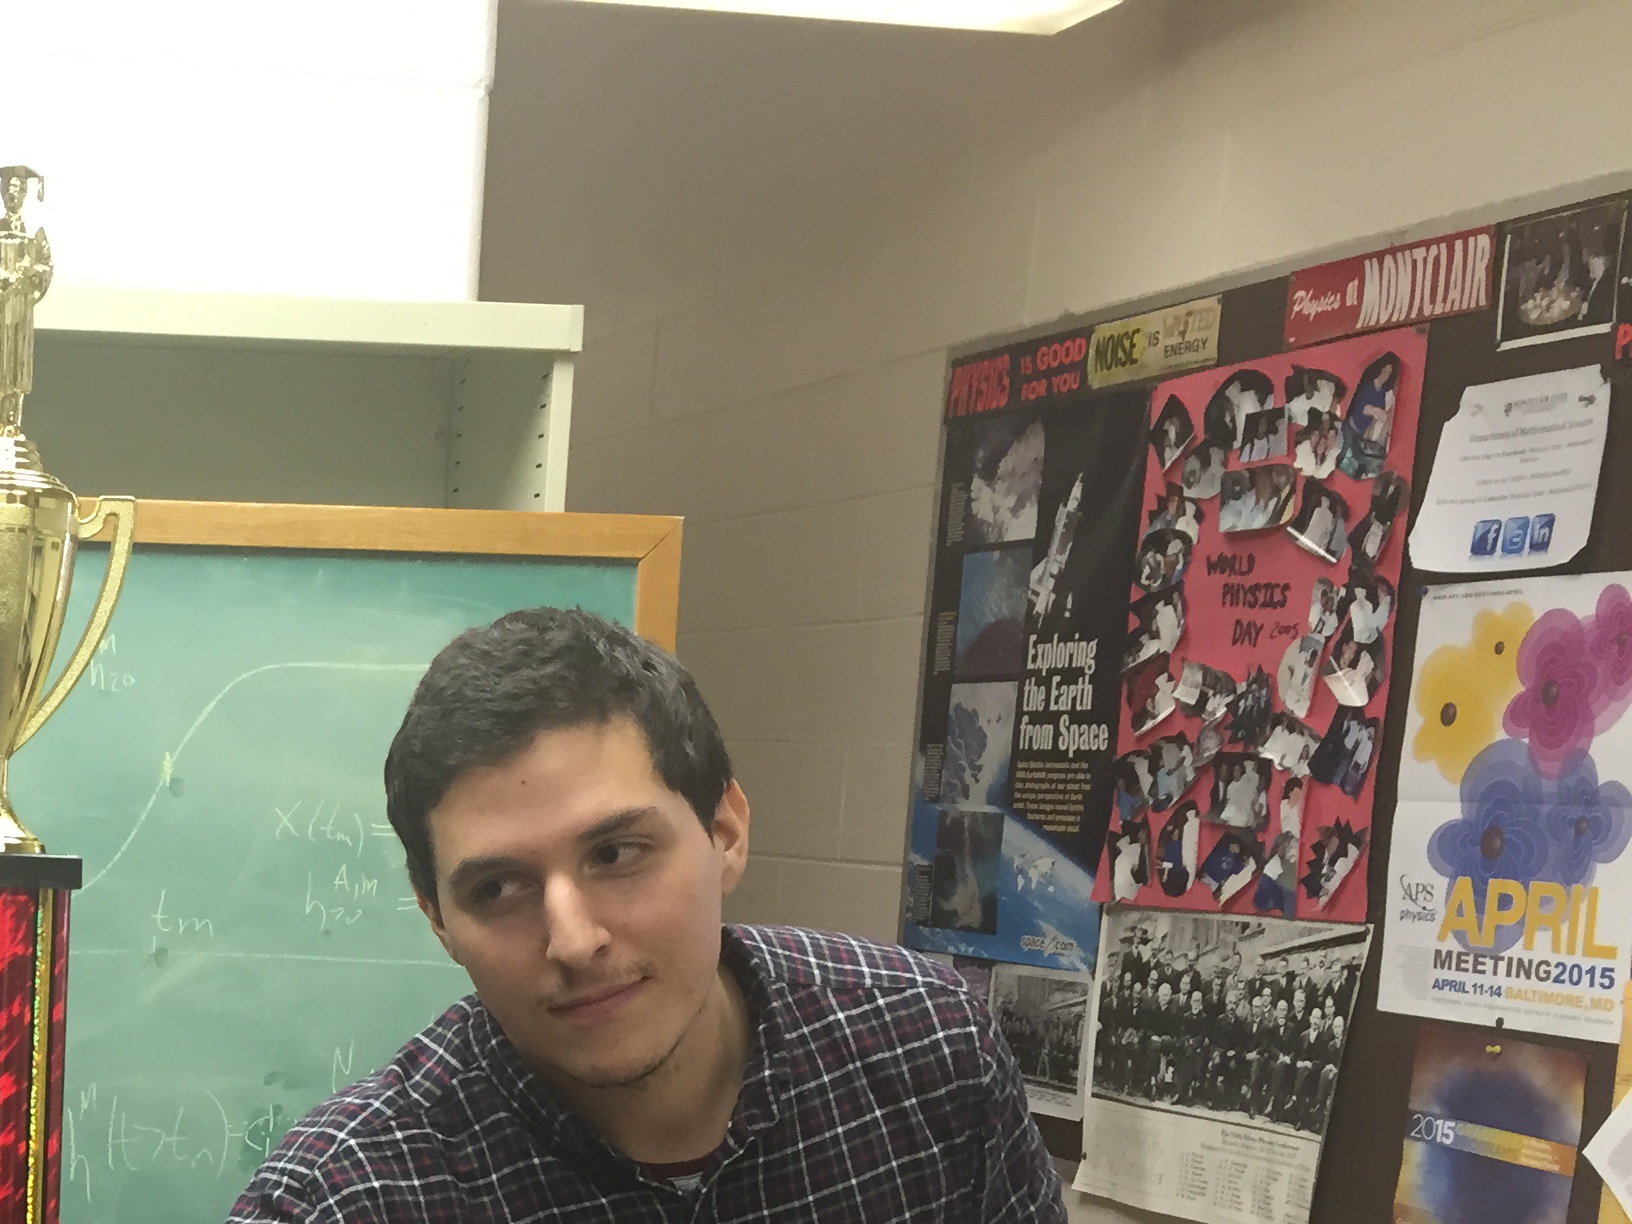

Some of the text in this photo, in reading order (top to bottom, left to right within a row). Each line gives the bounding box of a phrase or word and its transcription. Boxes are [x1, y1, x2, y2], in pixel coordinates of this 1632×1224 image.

[1290, 289, 1341, 322] Physics
[1355, 232, 1492, 330] MONTCLAIR
[1094, 327, 1161, 374] NOISE IS
[1163, 337, 1209, 359] ENERGY
[947, 353, 1011, 418] PHYSICS
[1036, 336, 1087, 372] GOOD
[1020, 369, 1081, 402] FOR YOU
[1206, 552, 1256, 578] WORLD
[1221, 582, 1292, 610] PHYSICS
[1231, 618, 1265, 648] DAY
[1026, 632, 1099, 676] Exploring
[1023, 674, 1094, 712] the Earth
[1019, 714, 1109, 758] from Space
[1399, 908, 1436, 923] physics
[1437, 875, 1618, 960] APRIL
[1432, 978, 1469, 994] APRIL
[1471, 982, 1503, 998] 11-14
[1410, 1112, 1457, 1145] 2015
